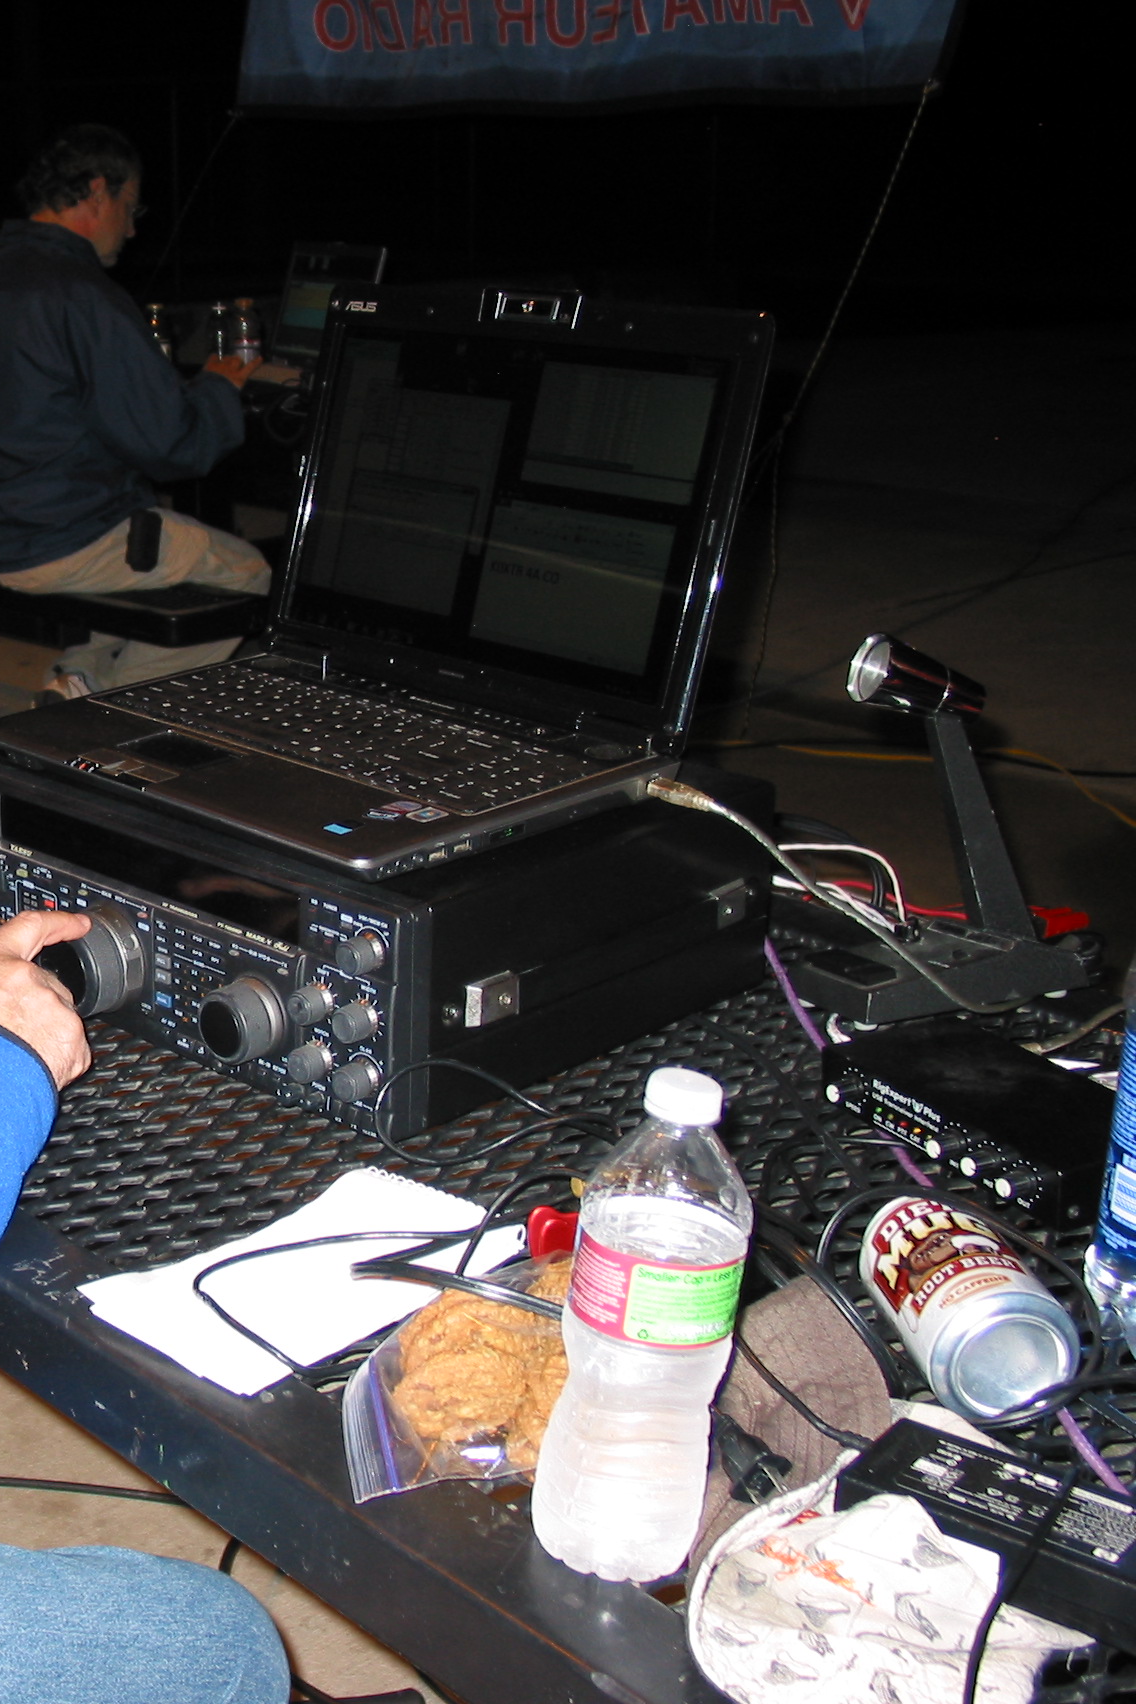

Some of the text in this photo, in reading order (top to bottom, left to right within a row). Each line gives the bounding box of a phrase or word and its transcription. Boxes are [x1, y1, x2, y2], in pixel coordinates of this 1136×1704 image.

[345, 300, 378, 313] ASUS
[877, 1210, 1001, 1290] MUG
[637, 1266, 681, 1283] Smaller
[683, 1273, 704, 1286] Cap
[914, 1263, 957, 1307] ROOT
